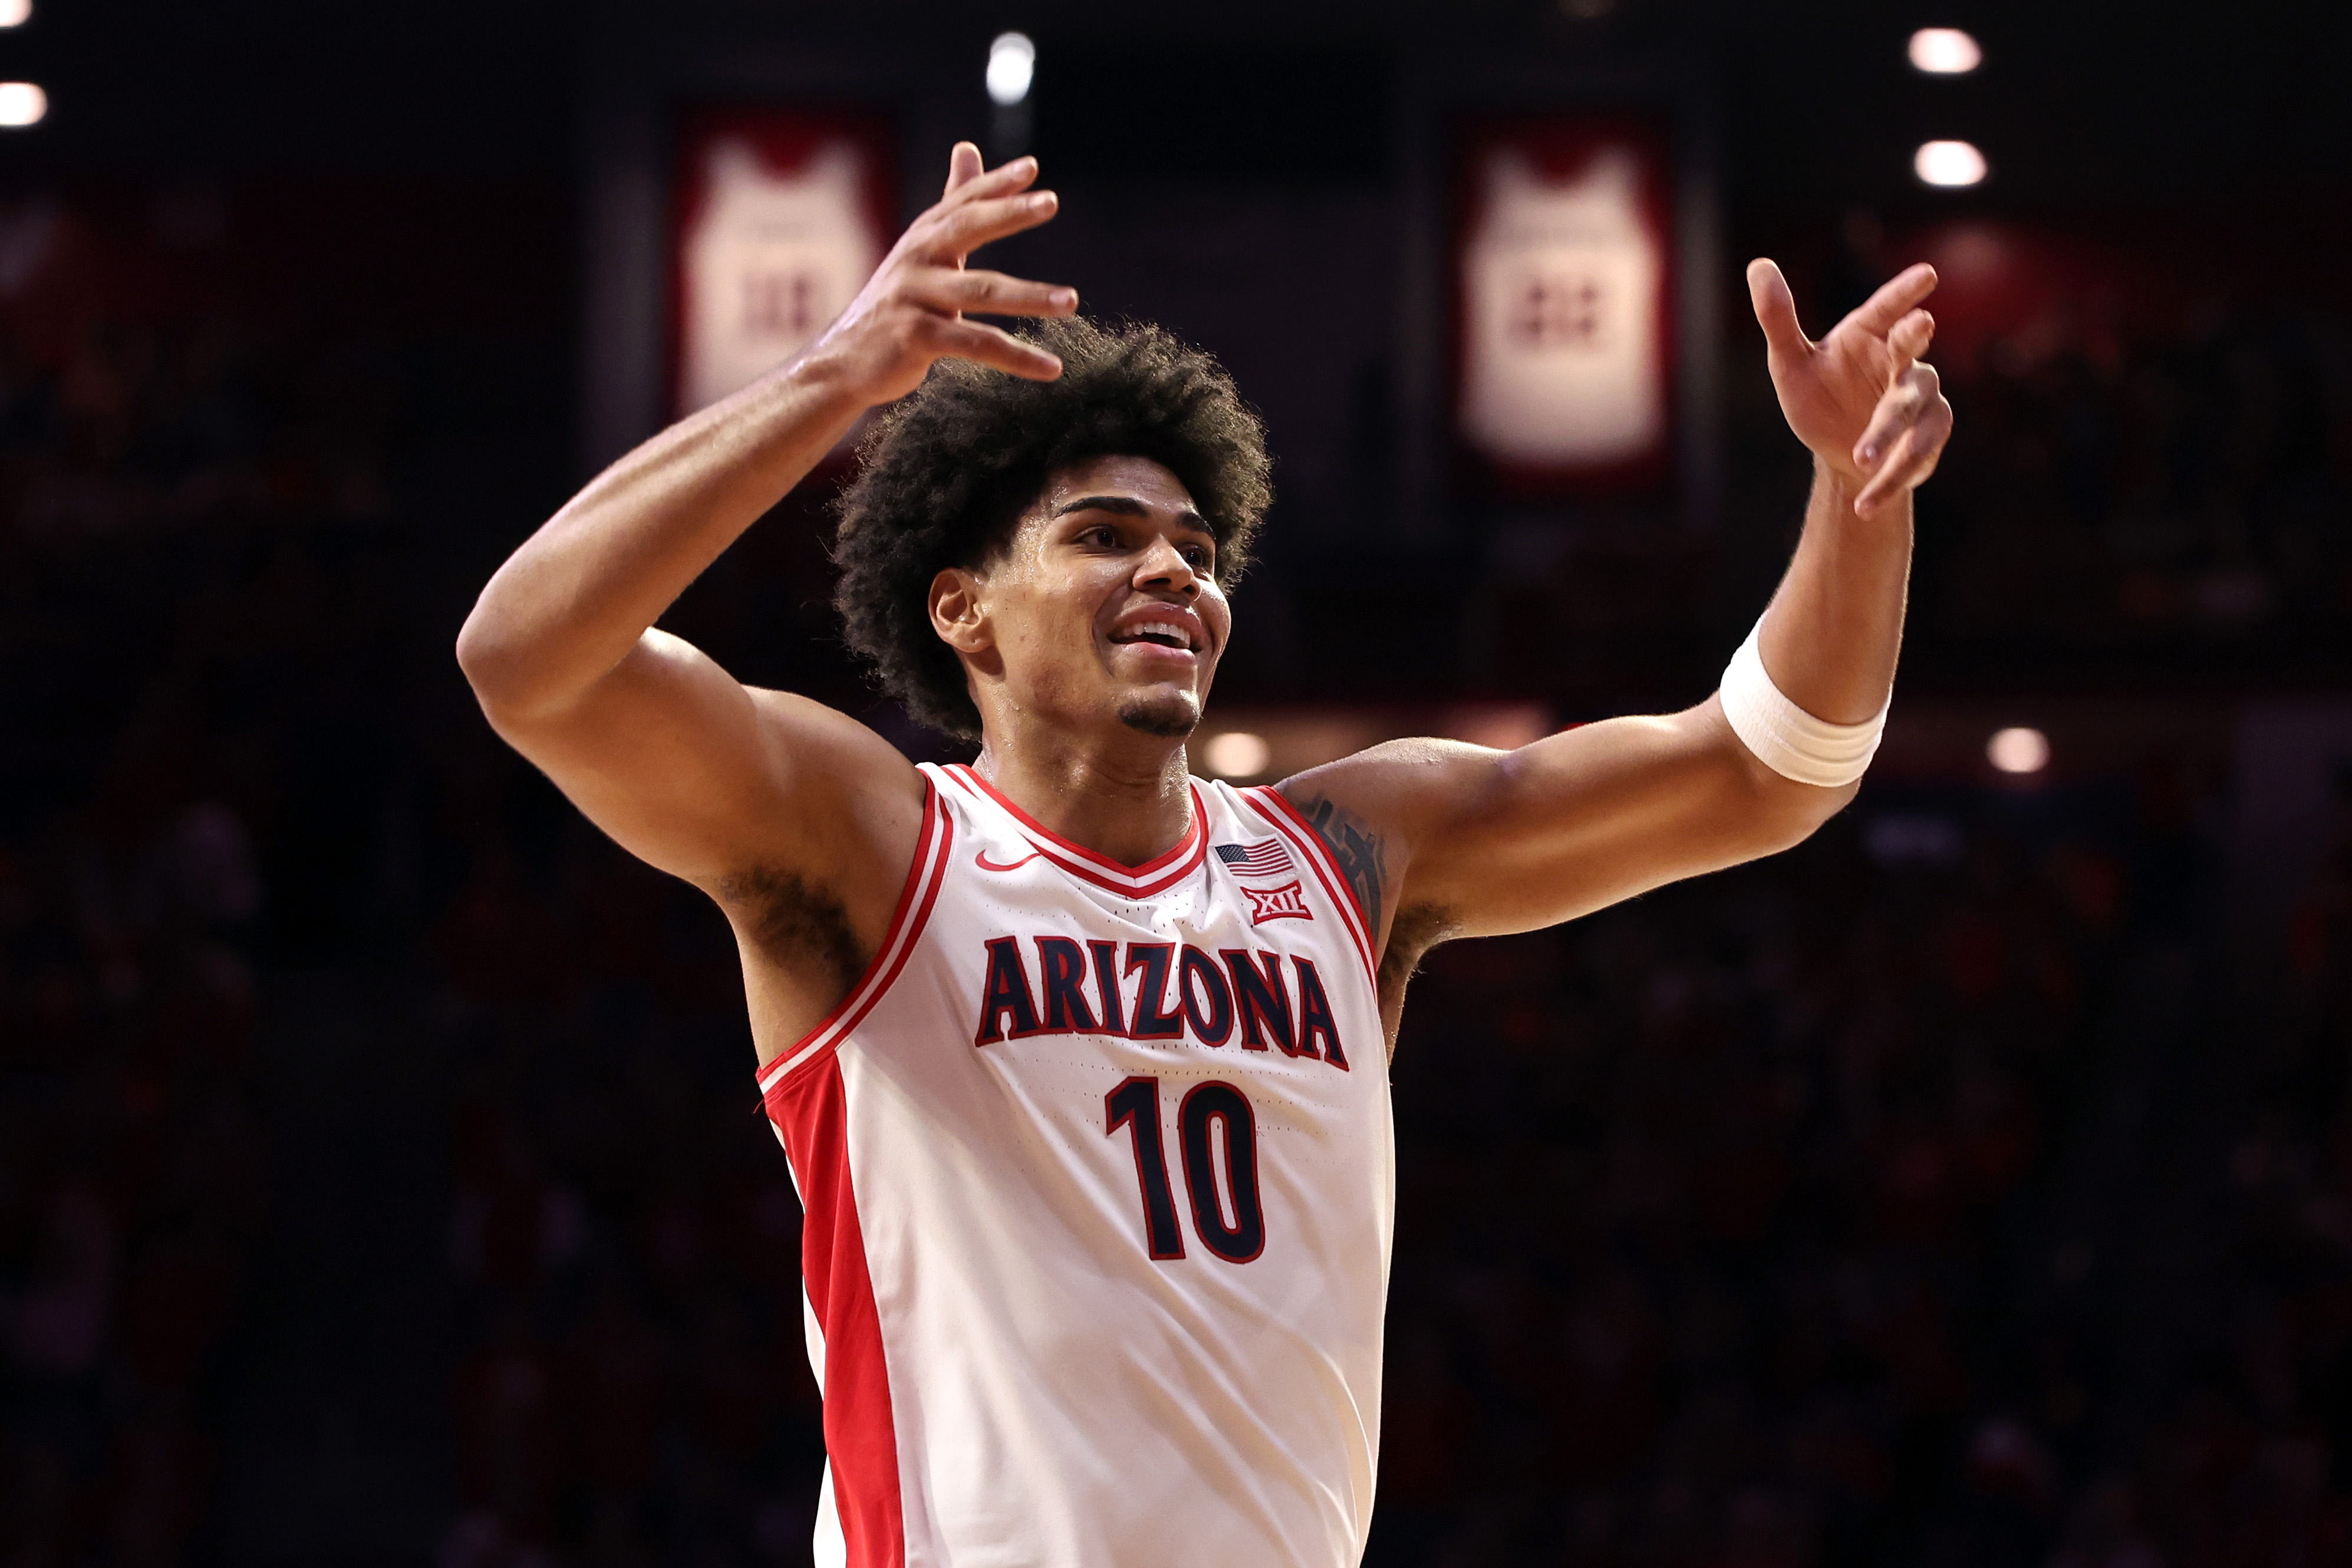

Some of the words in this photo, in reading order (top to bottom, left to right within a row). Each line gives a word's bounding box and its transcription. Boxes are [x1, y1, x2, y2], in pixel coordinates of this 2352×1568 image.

[1245, 884, 1309, 919] XII
[975, 935, 1349, 1072] ARIZONA
[1105, 1076, 1266, 1264] 10
